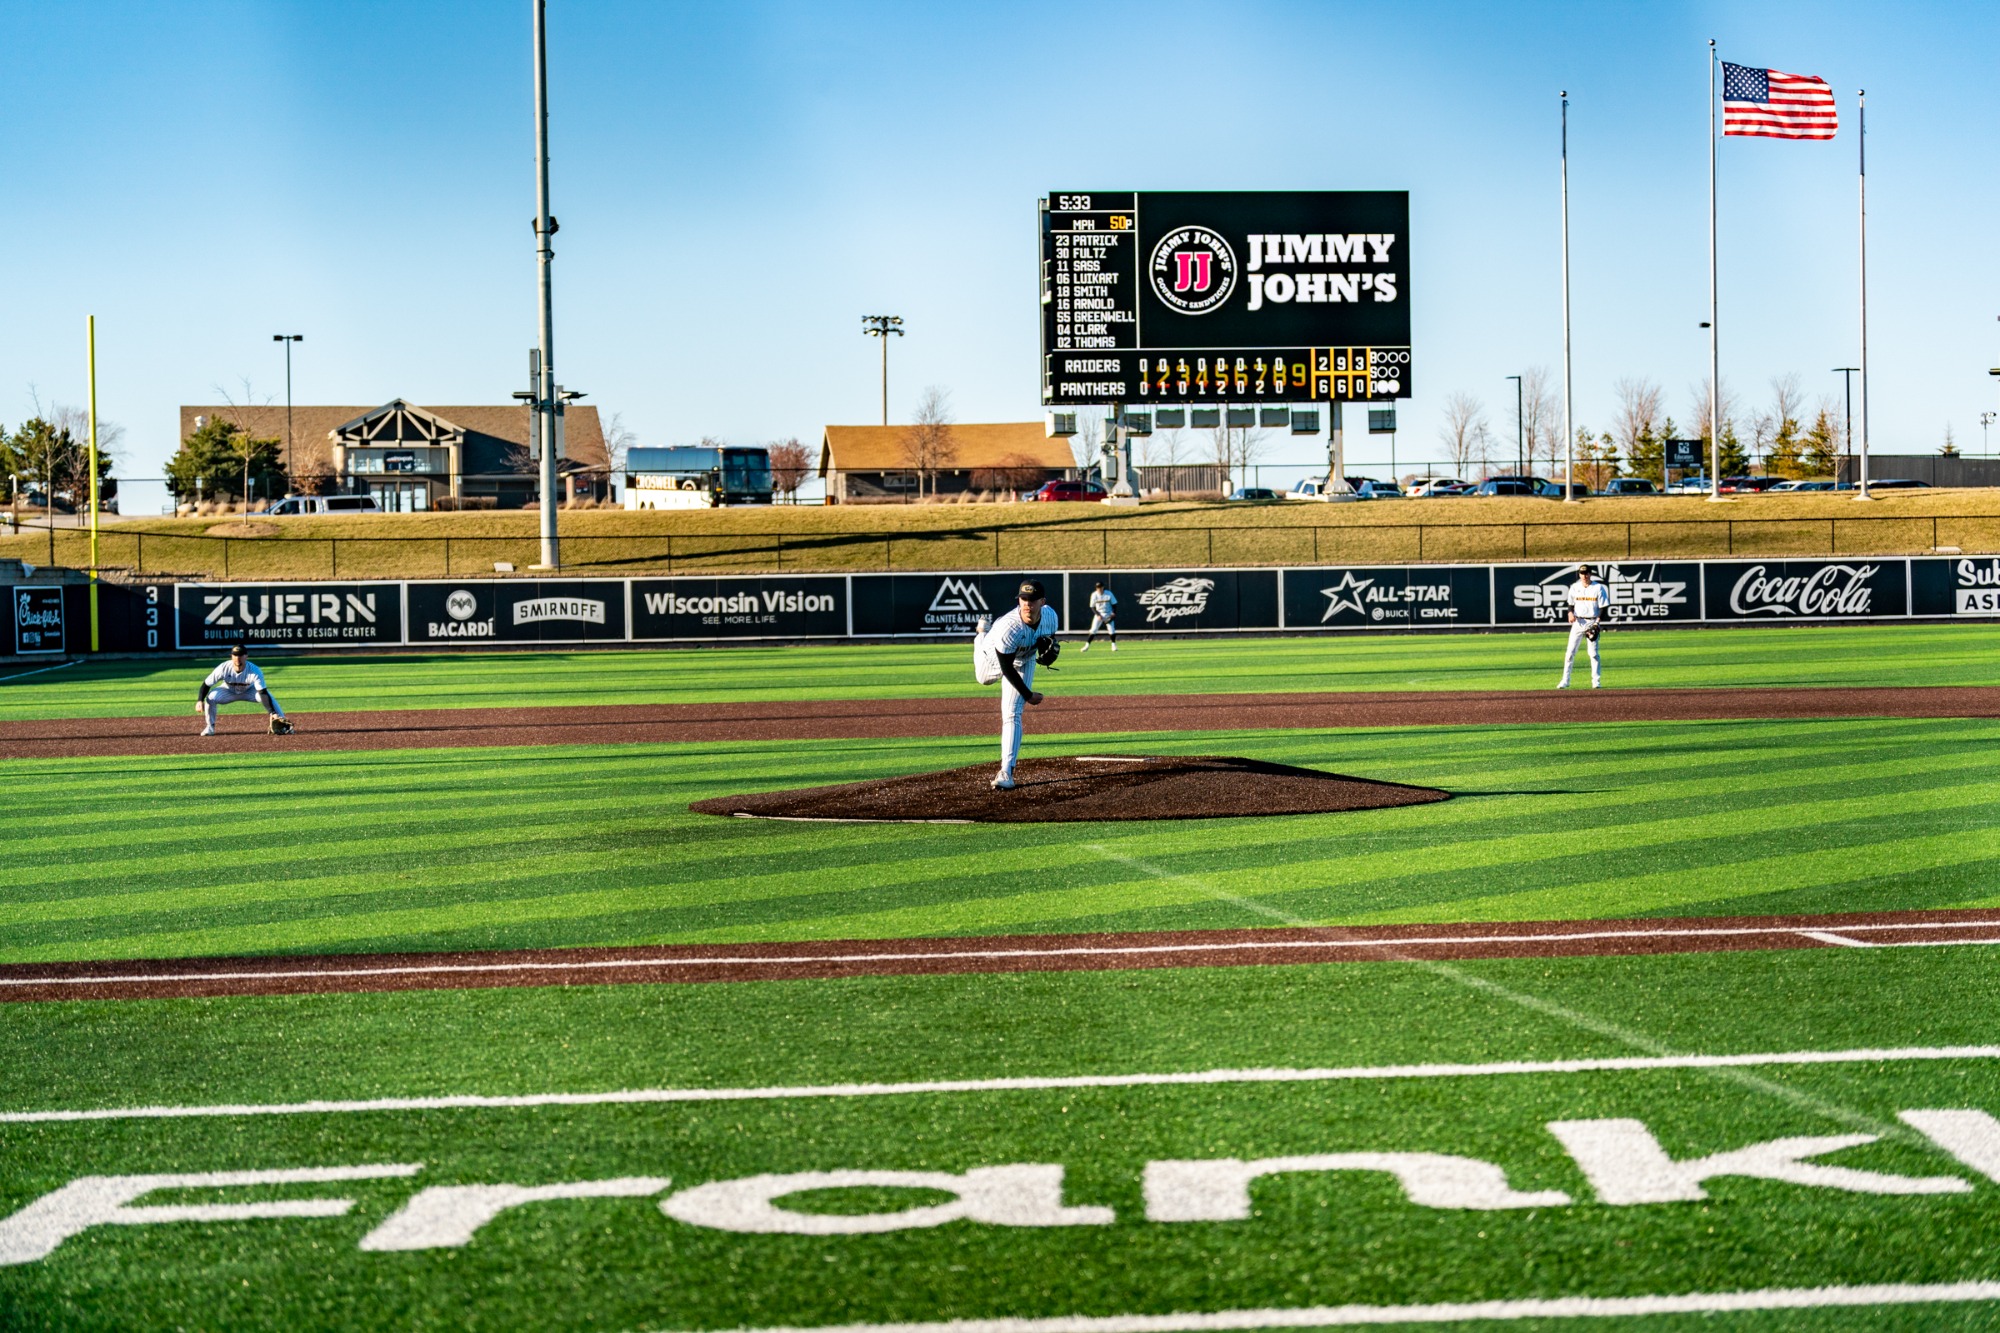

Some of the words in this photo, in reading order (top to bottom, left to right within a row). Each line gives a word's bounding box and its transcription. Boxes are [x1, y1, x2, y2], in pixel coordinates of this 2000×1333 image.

[1059, 195, 1091, 210] 5:33
[1073, 220, 1095, 230] MPH
[1056, 235, 1069, 246] 23
[1073, 235, 1118, 245] PATRICK
[1056, 248, 1069, 258] 30
[1073, 248, 1107, 258] FULTZ
[1155, 232, 1190, 272] JIMMY
[1247, 234, 1395, 271] JIMMY
[1057, 261, 1068, 271] 11
[1073, 261, 1100, 271] SASS
[1175, 252, 1213, 291] JJ
[1074, 273, 1119, 284] LUIKART
[1057, 286, 1070, 296] 18
[1074, 286, 1108, 296] SMITH
[1157, 277, 1188, 307] GOURMET
[1189, 277, 1230, 308] SANDWICHES
[1247, 273, 1397, 311] JOHN'S
[1057, 299, 1070, 309] 16
[1074, 298, 1114, 309] ARNOLD
[1074, 311, 1135, 322] GREENWELL
[1057, 324, 1070, 335] 04
[1074, 324, 1107, 334] CLARK
[1057, 337, 1071, 347] 02
[1074, 337, 1115, 347] THOMAS
[1065, 360, 1120, 373] RAIDERS
[1140, 359, 1148, 372] 0
[1159, 358, 1167, 372] 0
[1178, 358, 1185, 372] 1
[1198, 358, 1206, 372] 0
[1217, 358, 1225, 372] 0
[1236, 358, 1244, 372] 0
[1256, 358, 1262, 372] 1
[1275, 357, 1283, 371] 0
[1319, 357, 1328, 370] 2
[1337, 357, 1346, 370] 9
[1355, 357, 1364, 370] 3
[1370, 366, 1377, 378] S
[1292, 364, 1306, 387] 9
[1060, 382, 1126, 396] PANTHERS
[1140, 382, 1148, 395] 0
[1160, 382, 1167, 395] 1
[1179, 382, 1187, 395] 0
[1199, 381, 1206, 395] 1
[1217, 381, 1226, 394] 2
[1237, 380, 1244, 394] 0
[1256, 380, 1264, 394] 2
[1275, 380, 1283, 394] 0
[1319, 379, 1328, 393] 6
[1337, 379, 1346, 393] 6
[1356, 379, 1364, 393] 0
[1365, 585, 1450, 603] ALL-STAR
[1513, 582, 1687, 607] SPERZ
[1730, 564, 1880, 615] Coca-Cola
[644, 592, 759, 615] Wisconsin
[762, 590, 834, 613] Vision
[1139, 592, 1209, 605] EAGLE
[204, 593, 376, 625] ZUERN
[520, 602, 597, 618] SMIRNOFF
[1146, 601, 1207, 624] Disposal
[1386, 609, 1409, 618] BUICK
[1421, 608, 1458, 618] GMC
[1607, 605, 1669, 617] GLOVES
[925, 613, 956, 623] GRANITE
[957, 613, 963, 623] &
[205, 630, 244, 639] BUILDING
[249, 629, 292, 638] PRODUCTS
[297, 629, 302, 637] &
[308, 628, 338, 637] DESIGN
[343, 627, 376, 637] CENTER
